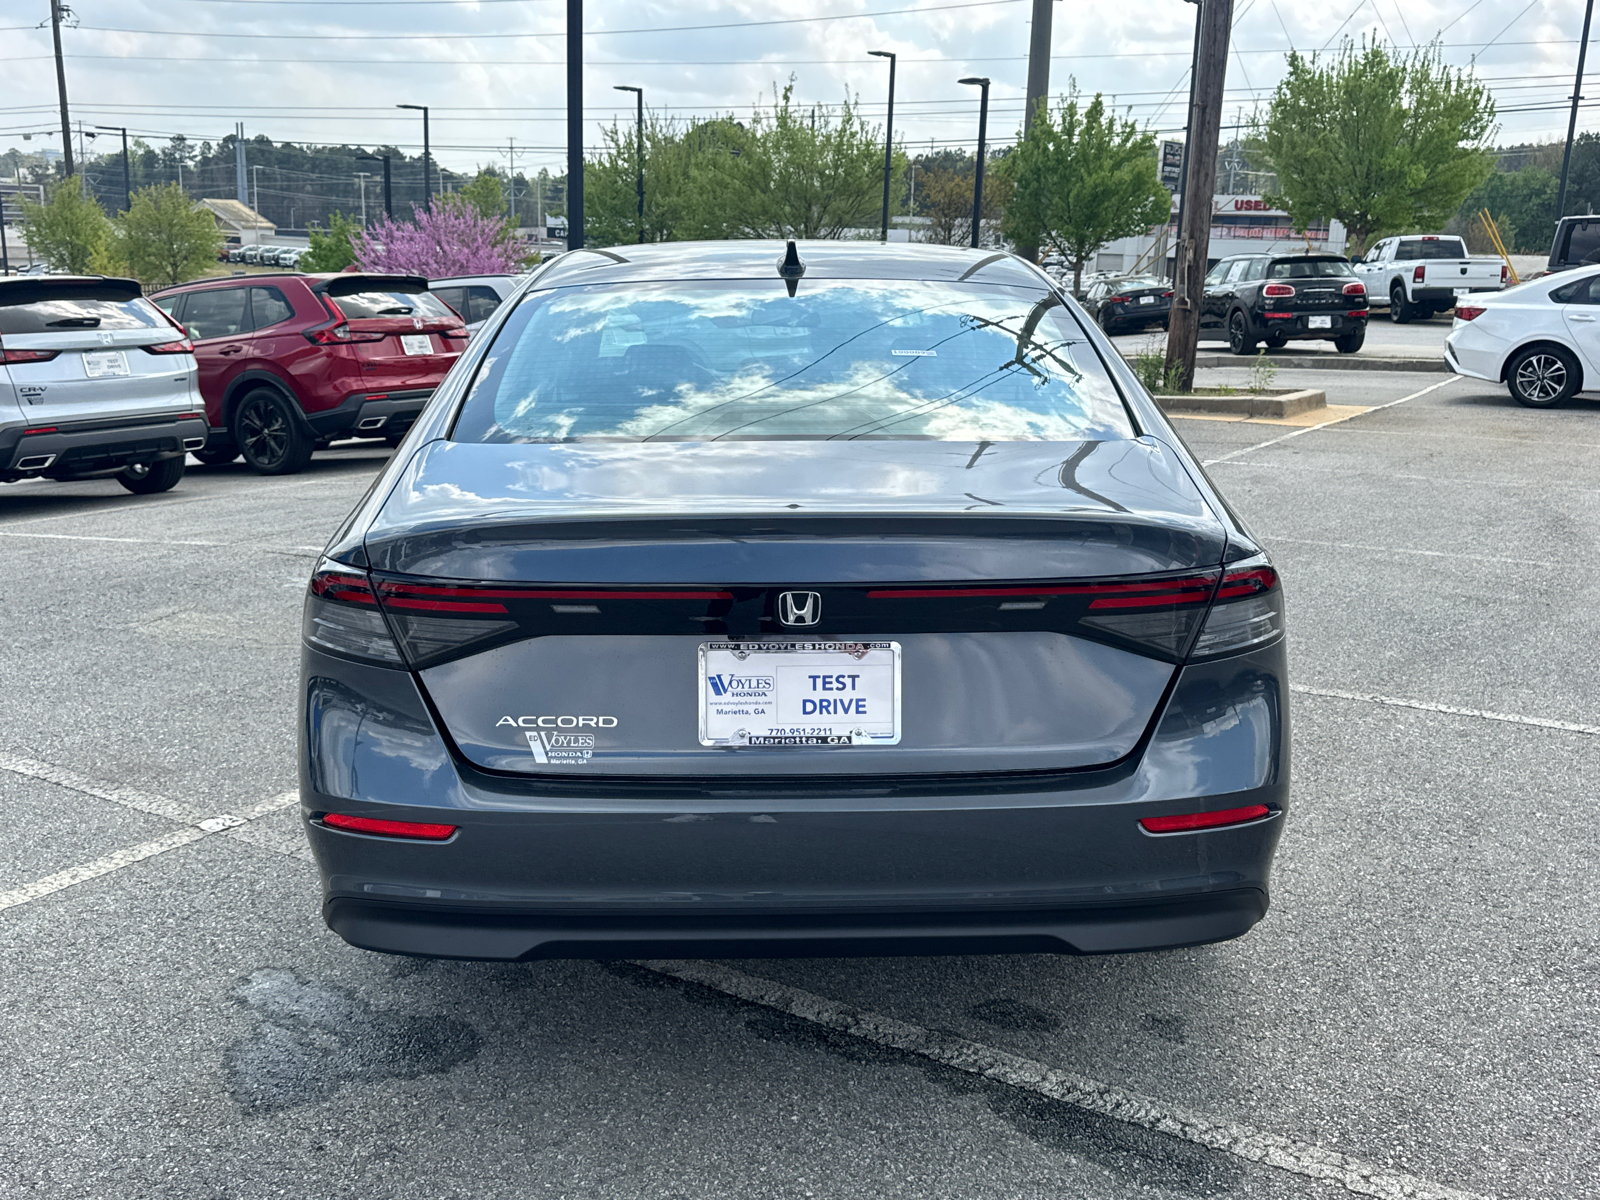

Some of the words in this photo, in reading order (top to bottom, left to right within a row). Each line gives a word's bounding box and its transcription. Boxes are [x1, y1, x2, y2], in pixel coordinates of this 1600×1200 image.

[1234, 199, 1271, 211] USED
[716, 674, 771, 694] VOYLES
[808, 674, 860, 691] TEST
[802, 698, 867, 715] DRIVE
[495, 715, 618, 728] ACCORD
[768, 727, 833, 735] 770-951-2211
[540, 731, 593, 751] VOYLES
[751, 736, 822, 744] Marietta,
[827, 736, 850, 744] GA
